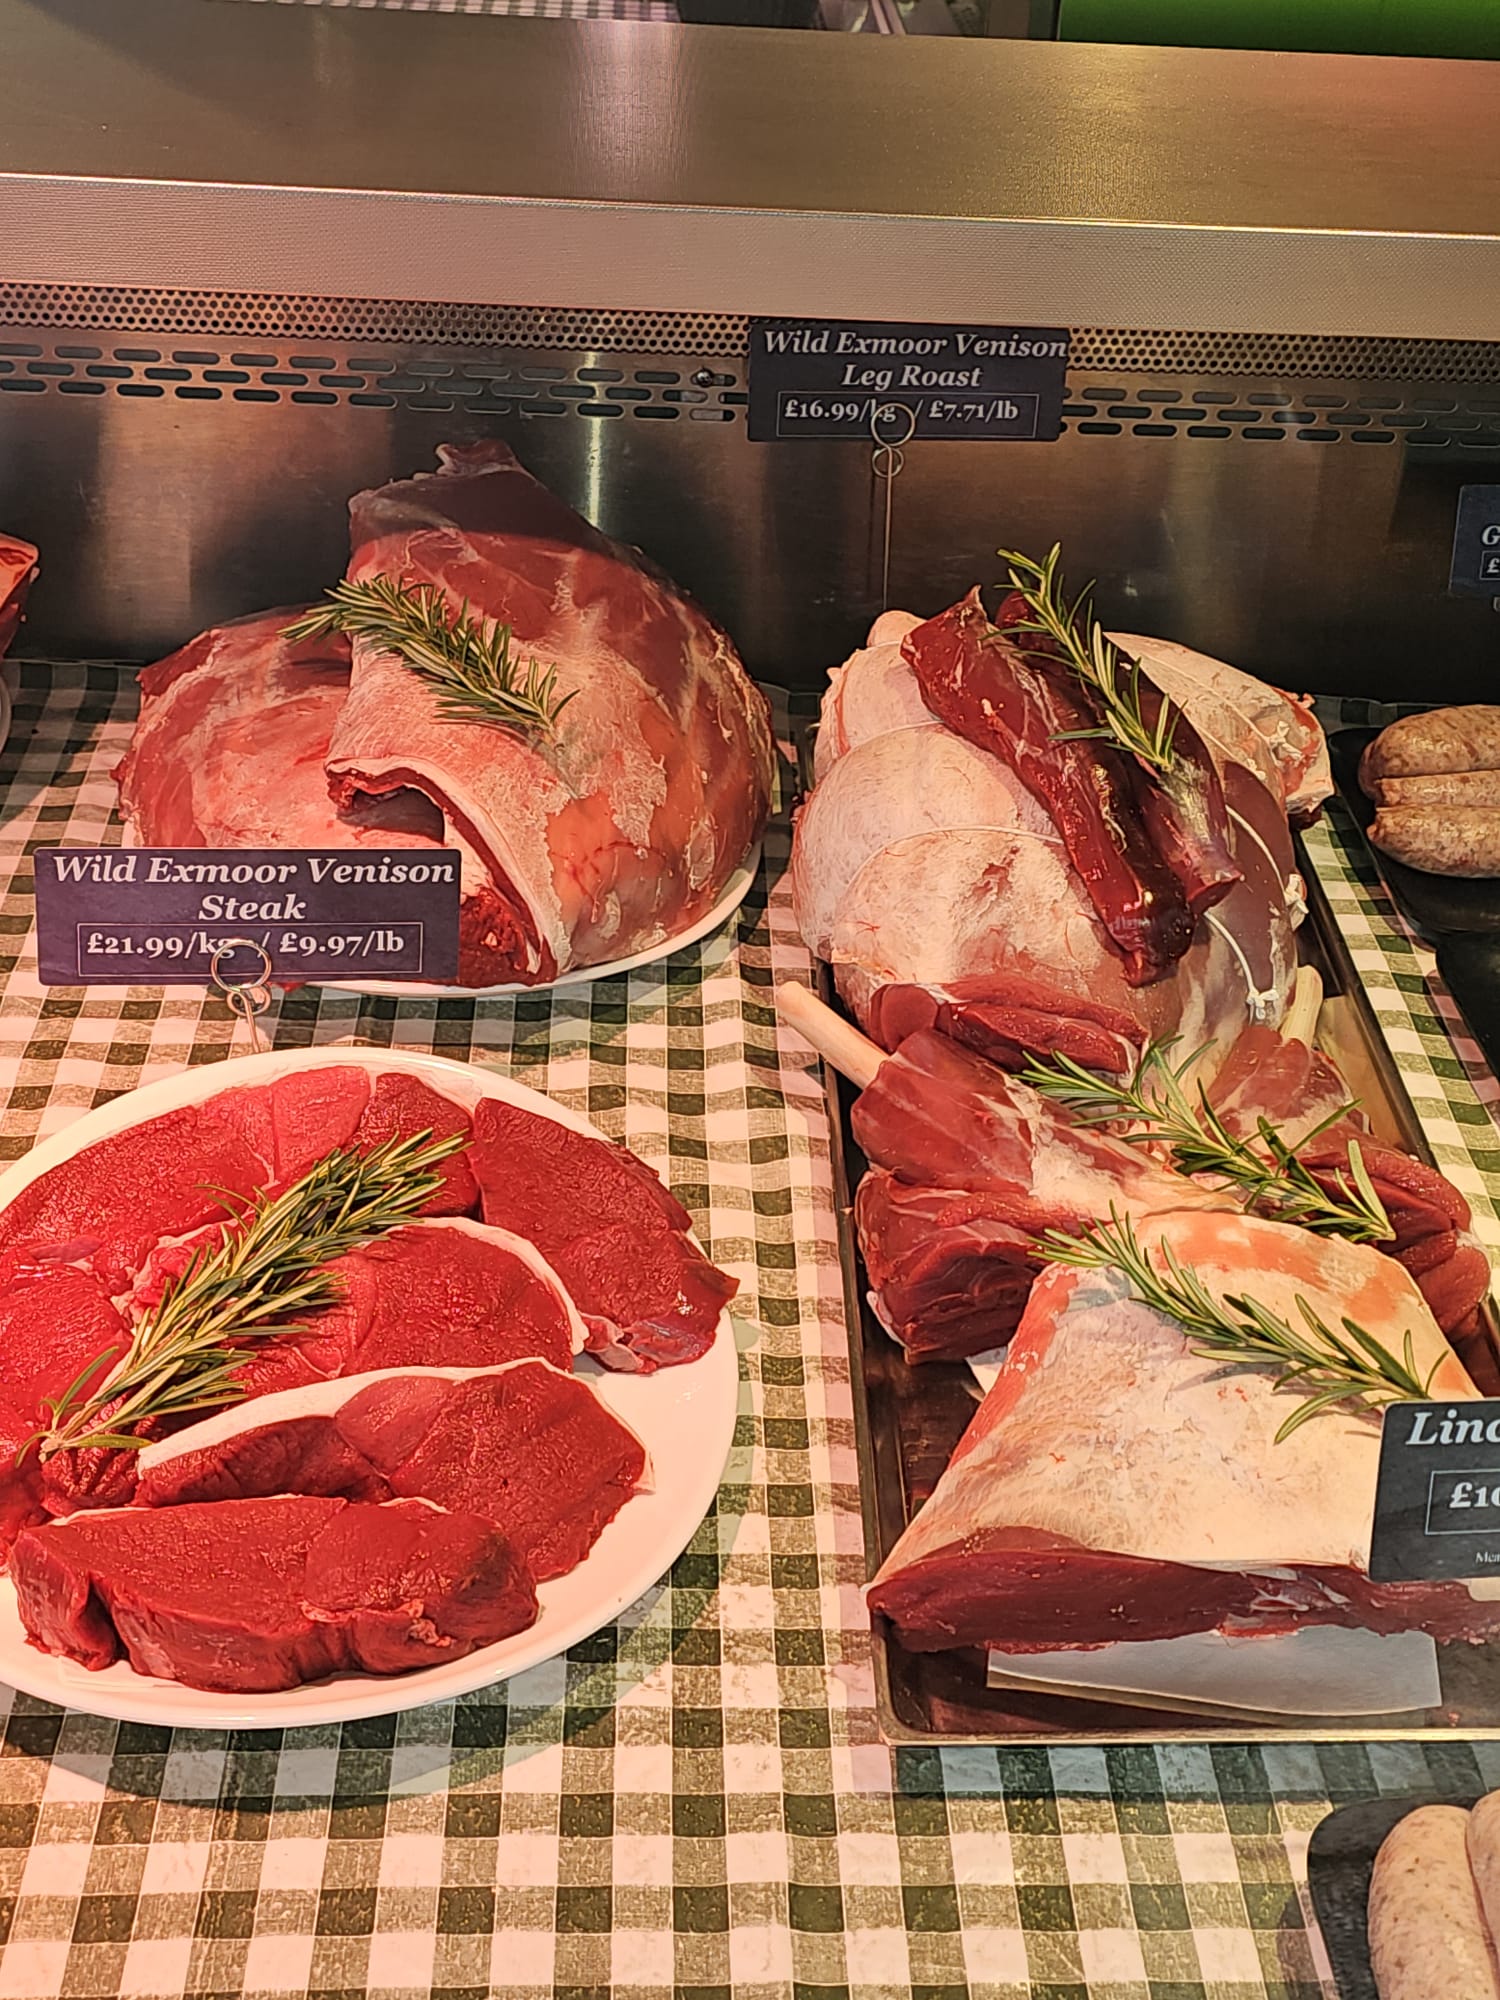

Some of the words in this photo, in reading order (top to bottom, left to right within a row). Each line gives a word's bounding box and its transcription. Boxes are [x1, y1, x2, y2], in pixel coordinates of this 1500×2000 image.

[764, 330, 829, 354] Wild
[834, 331, 948, 356] Exmoor
[954, 333, 1068, 358] Venison
[841, 364, 894, 391] Leg
[898, 364, 984, 388] Roast
[928, 400, 1019, 425] £7.71/lb
[52, 855, 137, 883] Wild
[144, 856, 299, 884] Exmoor
[307, 856, 456, 884] Venison
[198, 893, 307, 921] Steak
[87, 931, 237, 960] £21.99/kg
[279, 930, 405, 958] £9.97/lb
